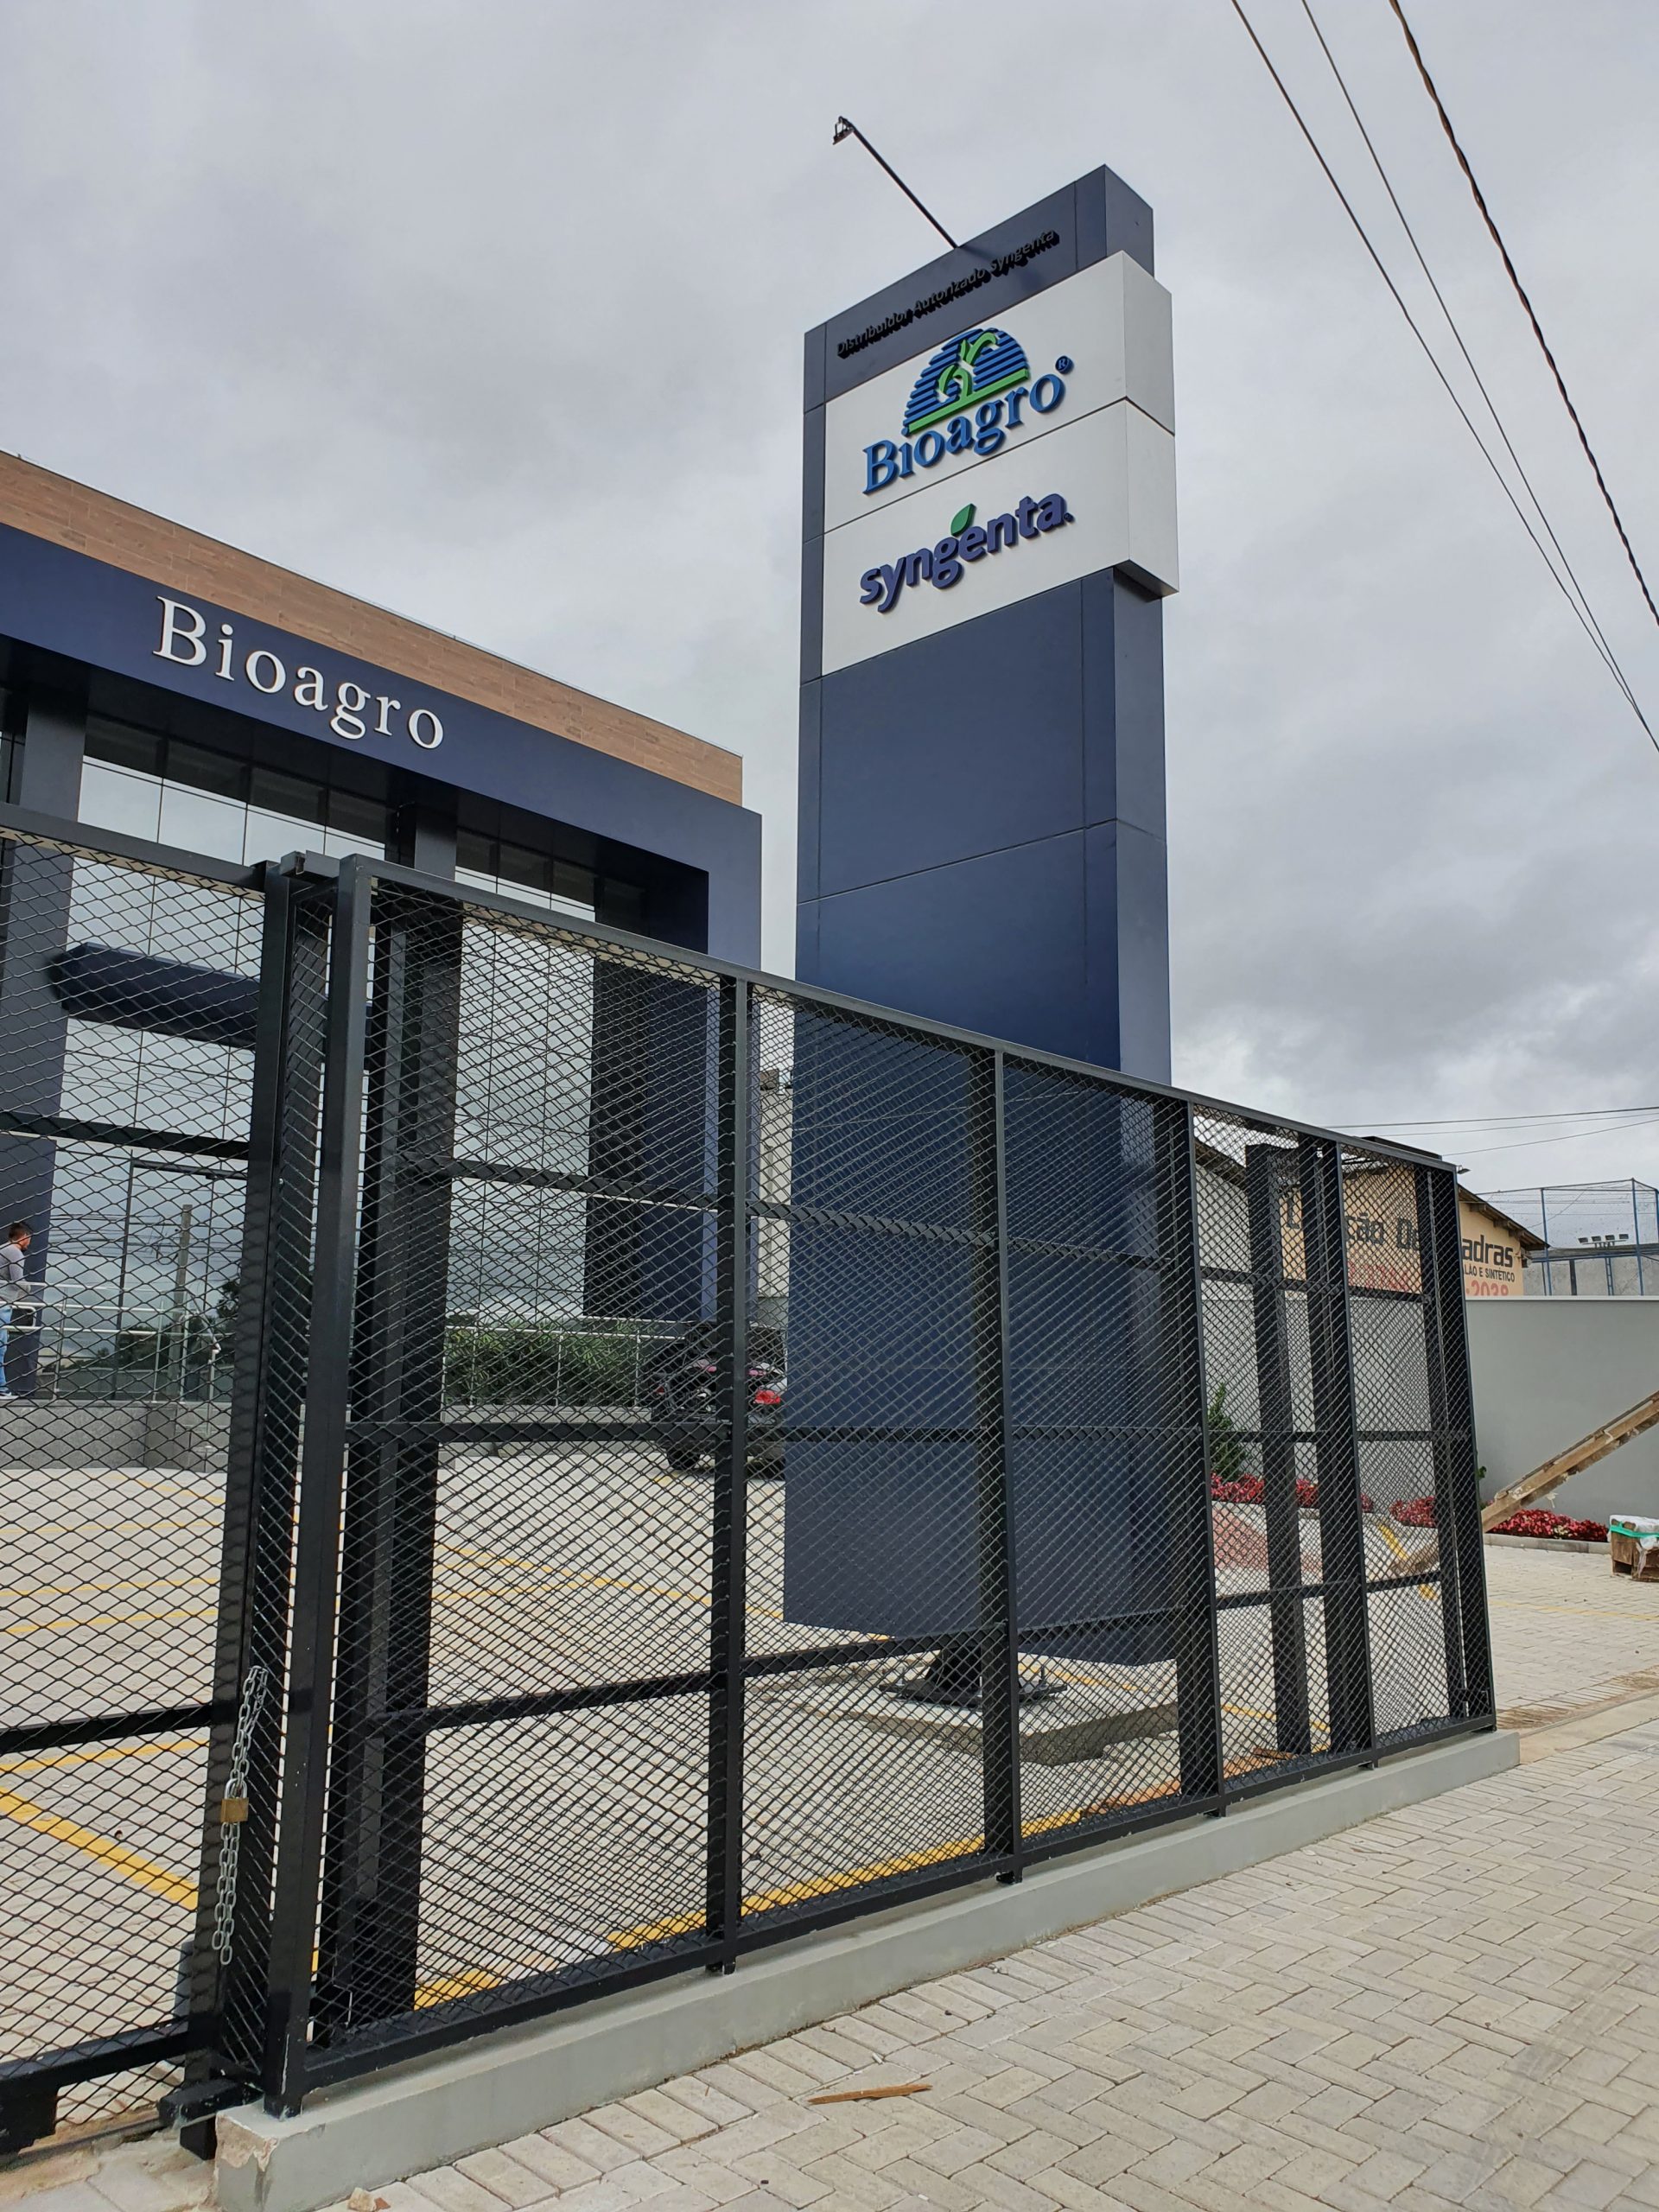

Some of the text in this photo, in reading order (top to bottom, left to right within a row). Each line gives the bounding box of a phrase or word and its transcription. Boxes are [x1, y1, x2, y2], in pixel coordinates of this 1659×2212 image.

[836, 229, 1060, 359] Distribuidor Autorizado Syngenta
[862, 373, 1066, 495] Bioagro
[859, 493, 1067, 613] syngenta
[152, 595, 444, 750] Bioagro
[1461, 1234, 1514, 1268] adras
